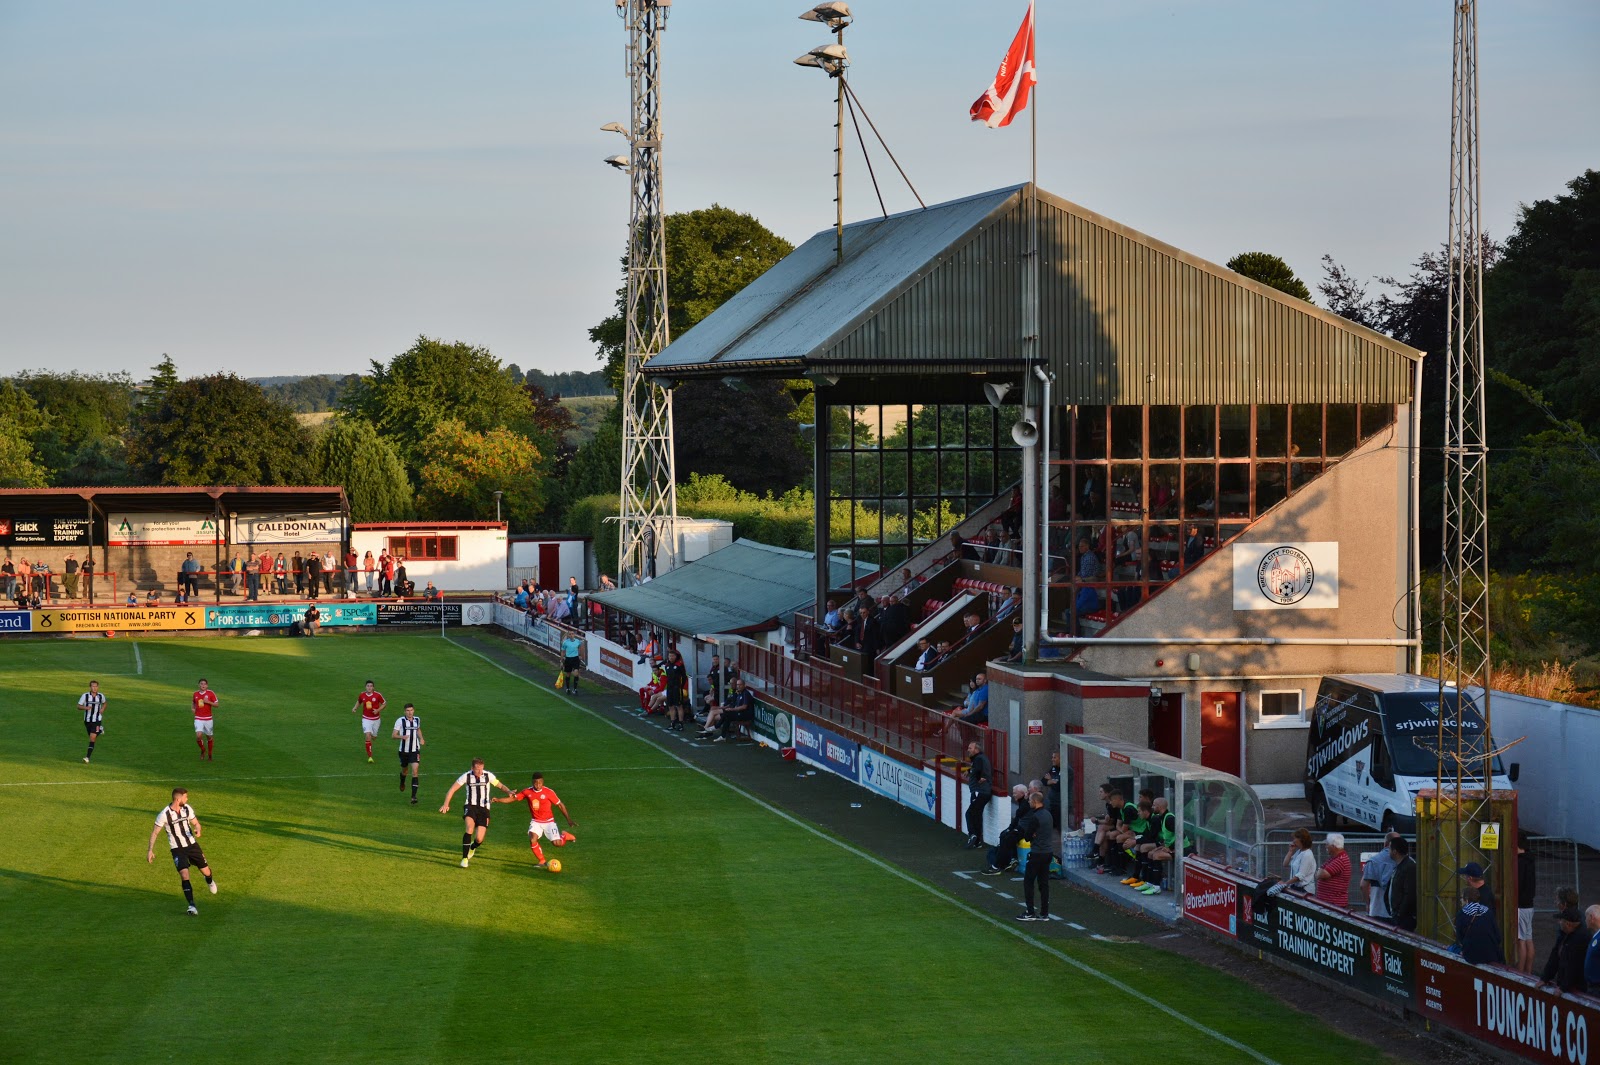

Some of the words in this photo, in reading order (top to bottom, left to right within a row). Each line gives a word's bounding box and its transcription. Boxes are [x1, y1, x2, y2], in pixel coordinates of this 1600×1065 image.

[15, 521, 38, 532] Falck
[257, 522, 326, 531] CALEDONIAN
[1260, 561, 1268, 588] BRECHIN
[1267, 550, 1280, 561] CITY
[1282, 548, 1308, 565] FOOTBALL
[60, 612, 100, 622] SCOTTISH
[104, 612, 146, 620] NATIONAL
[148, 611, 176, 620] PARTY
[218, 616, 234, 625] FOR
[234, 615, 254, 624] SALE
[1396, 718, 1478, 730] srjwindows
[796, 727, 814, 748] BETFRED
[826, 742, 846, 764] BETFRED
[1308, 718, 1369, 778] srjwindows
[1186, 886, 1235, 910] @brechincityfc
[1278, 906, 1294, 930] THE
[1294, 912, 1331, 944] WORLD'S
[1332, 927, 1364, 956] SAFETY
[1278, 929, 1319, 962] TRAINING
[1320, 946, 1354, 976] EXPERT
[1384, 952, 1402, 976] Falck
[1420, 958, 1446, 974] SOLICITORS
[1431, 975, 1435, 984] &
[1426, 986, 1442, 998] ESTATE
[1426, 999, 1443, 1012] AGENTS
[1474, 978, 1483, 1026] T
[1486, 982, 1546, 1052] DUNCAN
[1551, 1004, 1562, 1058] &
[1566, 1010, 1588, 1065] CO
